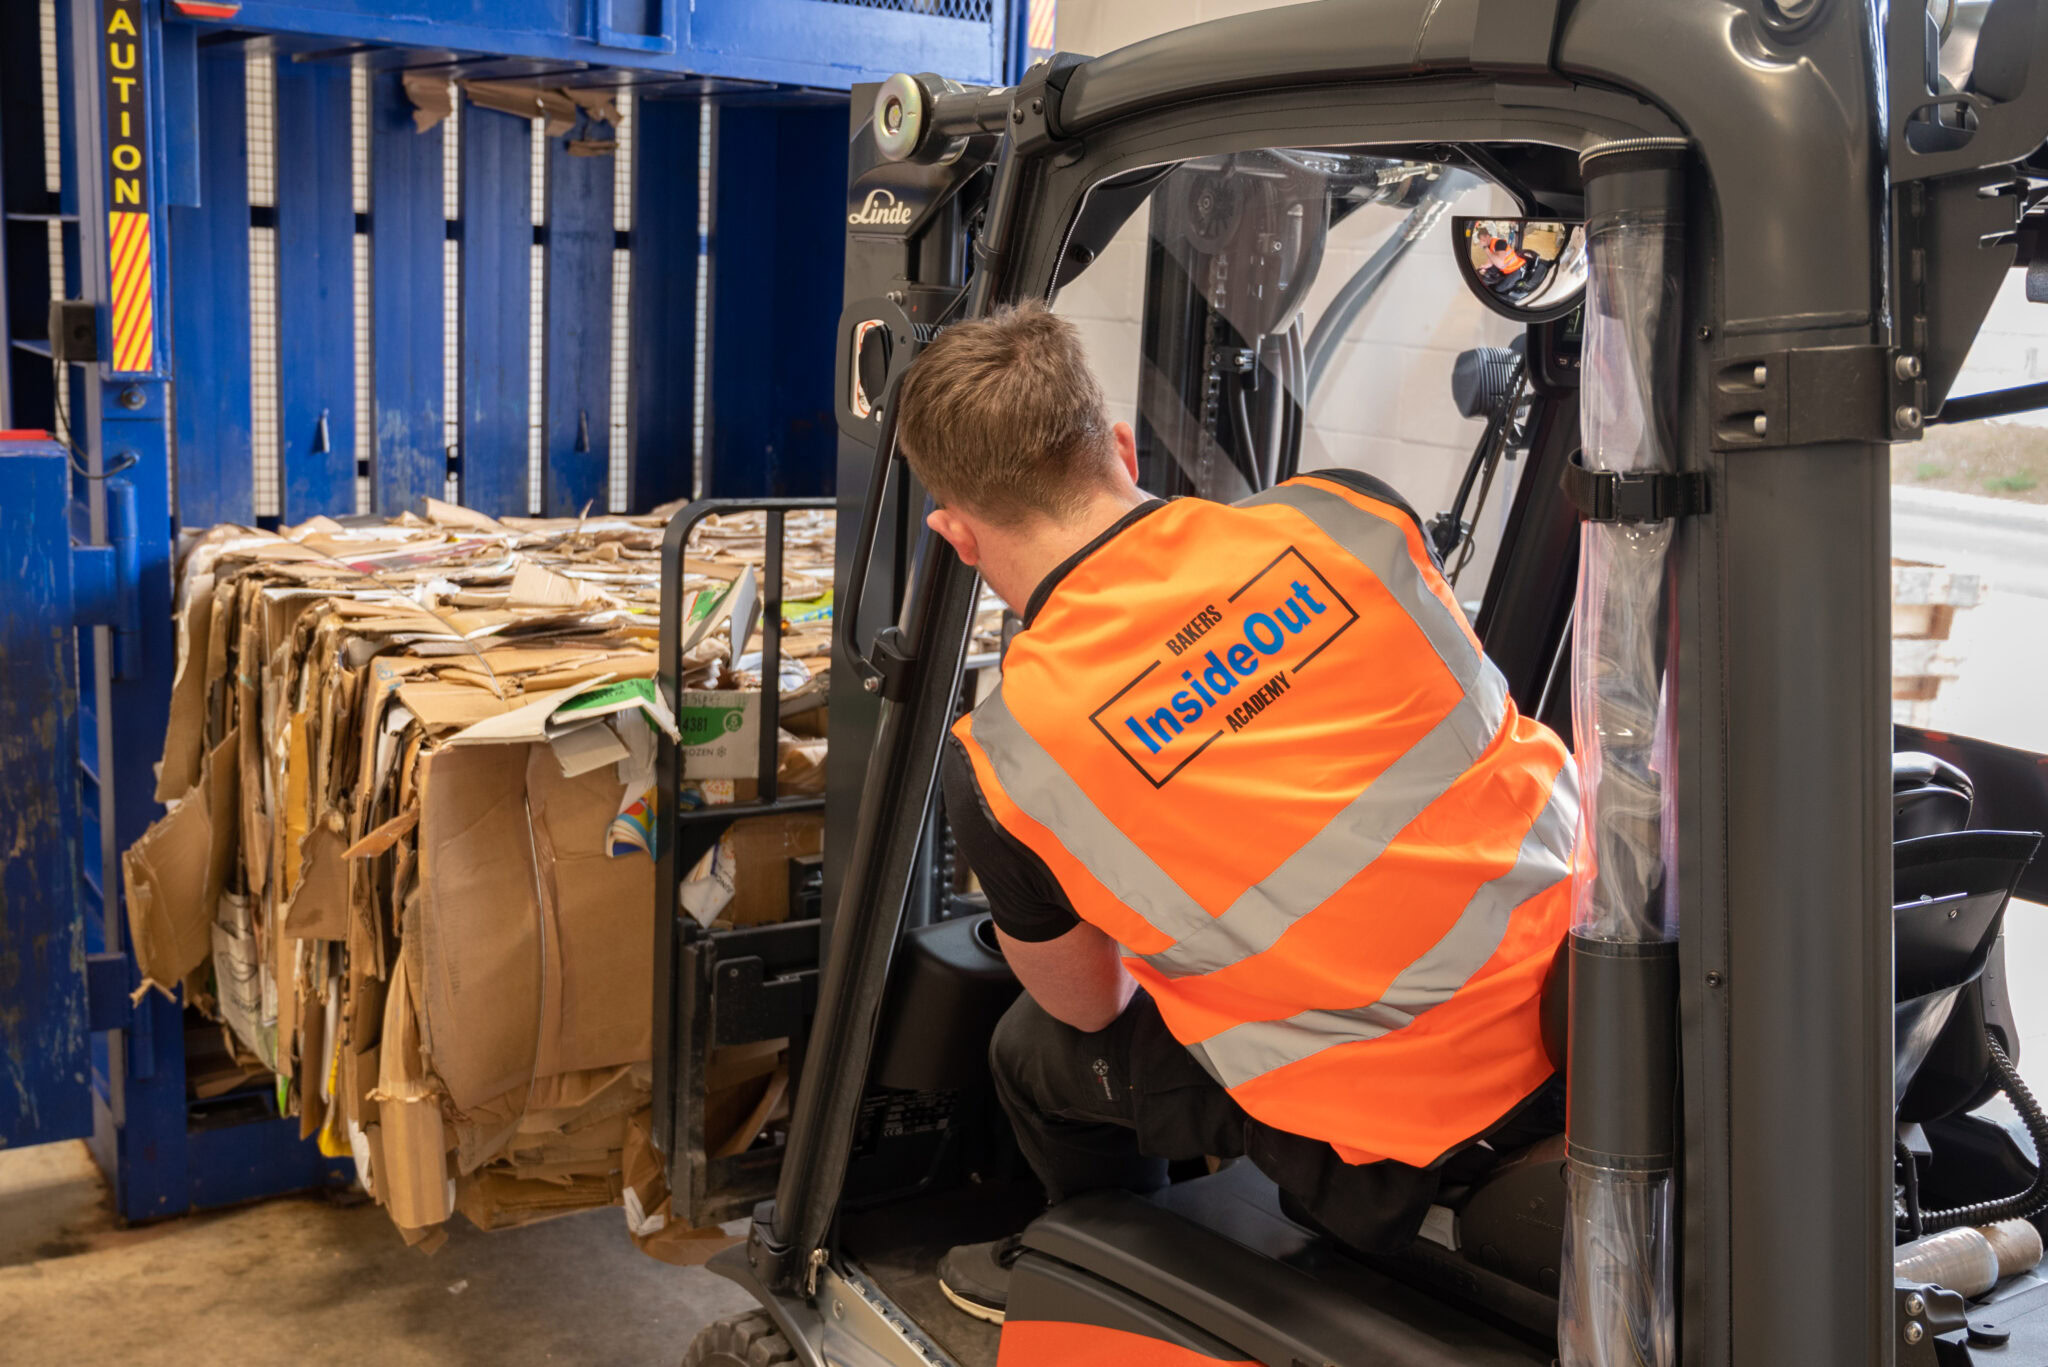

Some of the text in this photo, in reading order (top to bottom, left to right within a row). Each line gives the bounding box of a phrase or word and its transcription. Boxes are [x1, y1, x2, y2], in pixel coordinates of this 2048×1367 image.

[107, 0, 141, 205] AUTION
[849, 189, 911, 224] Linde
[1165, 604, 1222, 656] BAKERS
[1125, 580, 1327, 754] InsideOut
[1225, 671, 1291, 733] ACADEMY
[686, 748, 714, 757] OZEN
